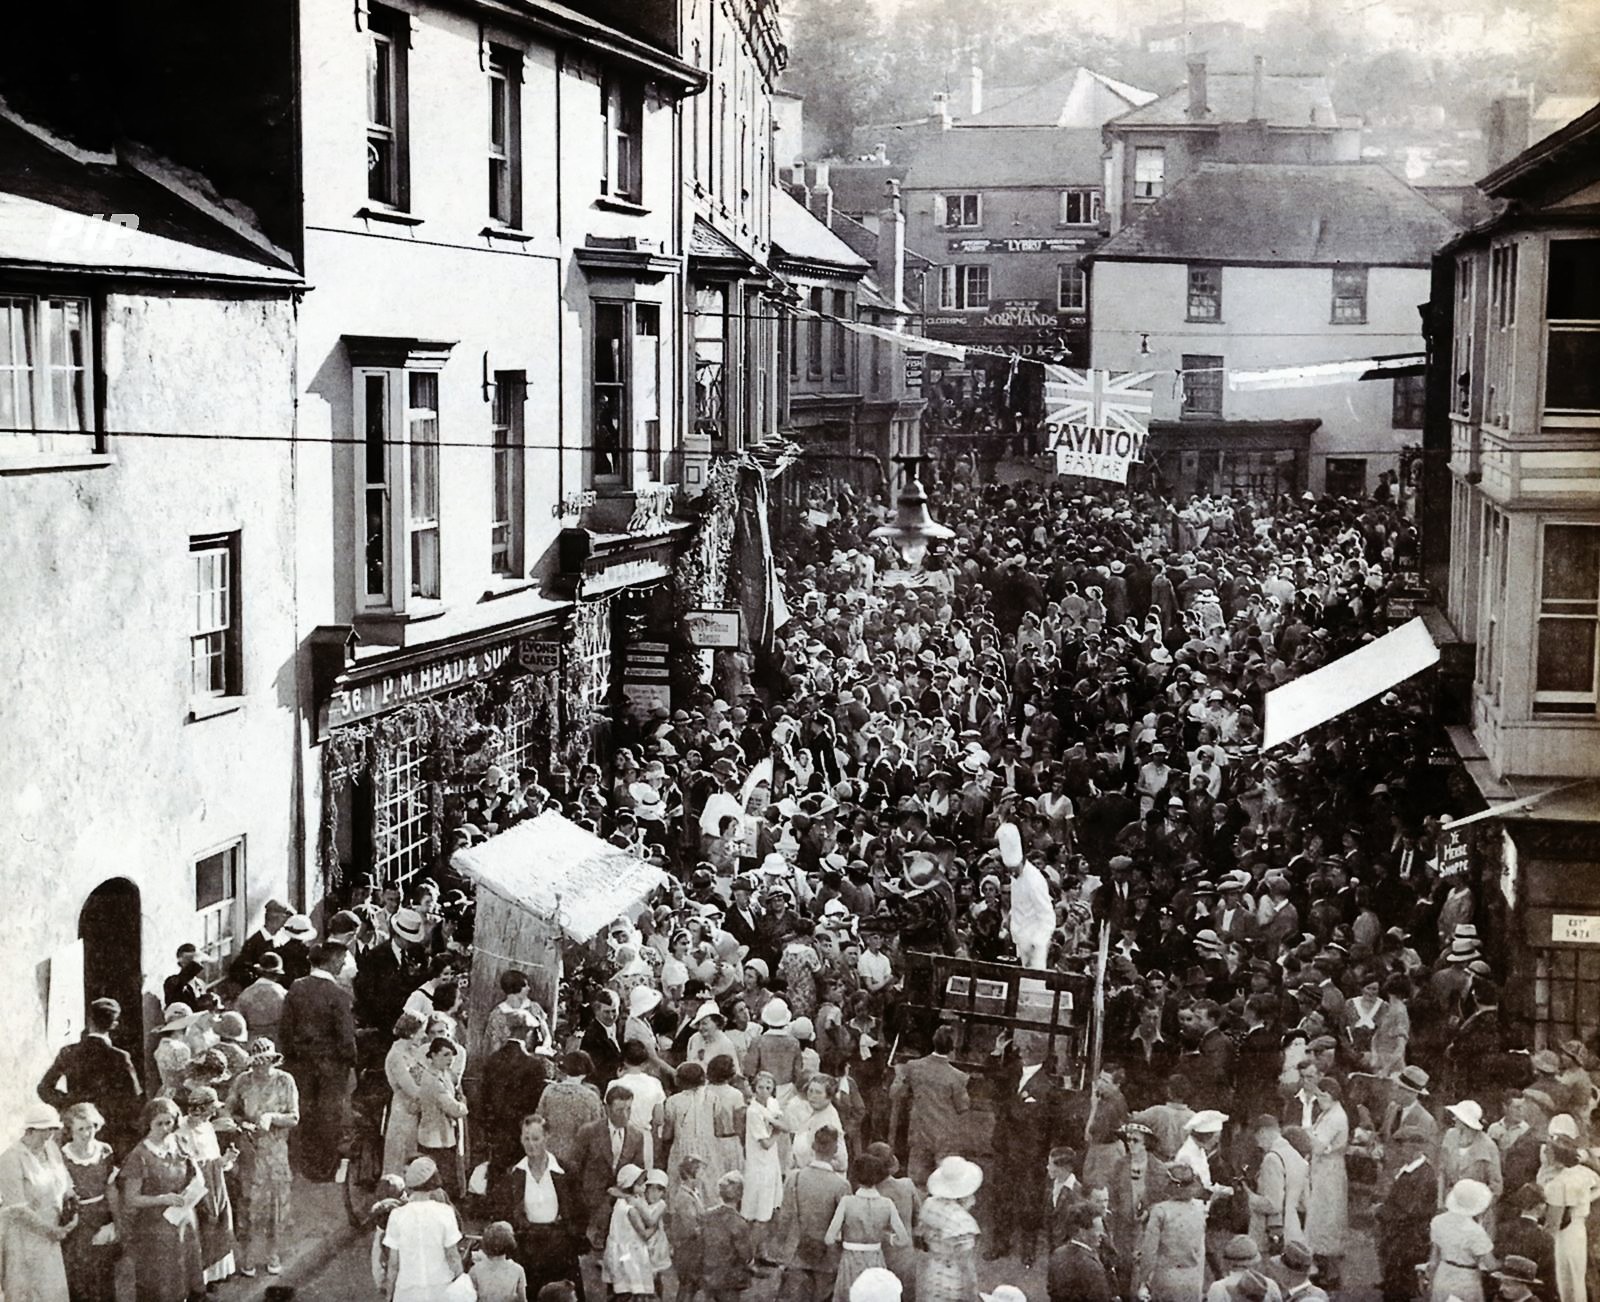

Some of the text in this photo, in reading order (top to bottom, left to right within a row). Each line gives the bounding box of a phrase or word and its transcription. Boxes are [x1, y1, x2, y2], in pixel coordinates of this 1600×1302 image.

[983, 311, 1058, 326] NORMANDS
[1045, 422, 1148, 461] PAYNTON
[522, 641, 557, 654] LYONS
[467, 654, 479, 678] &
[522, 654, 558, 666] CAKES
